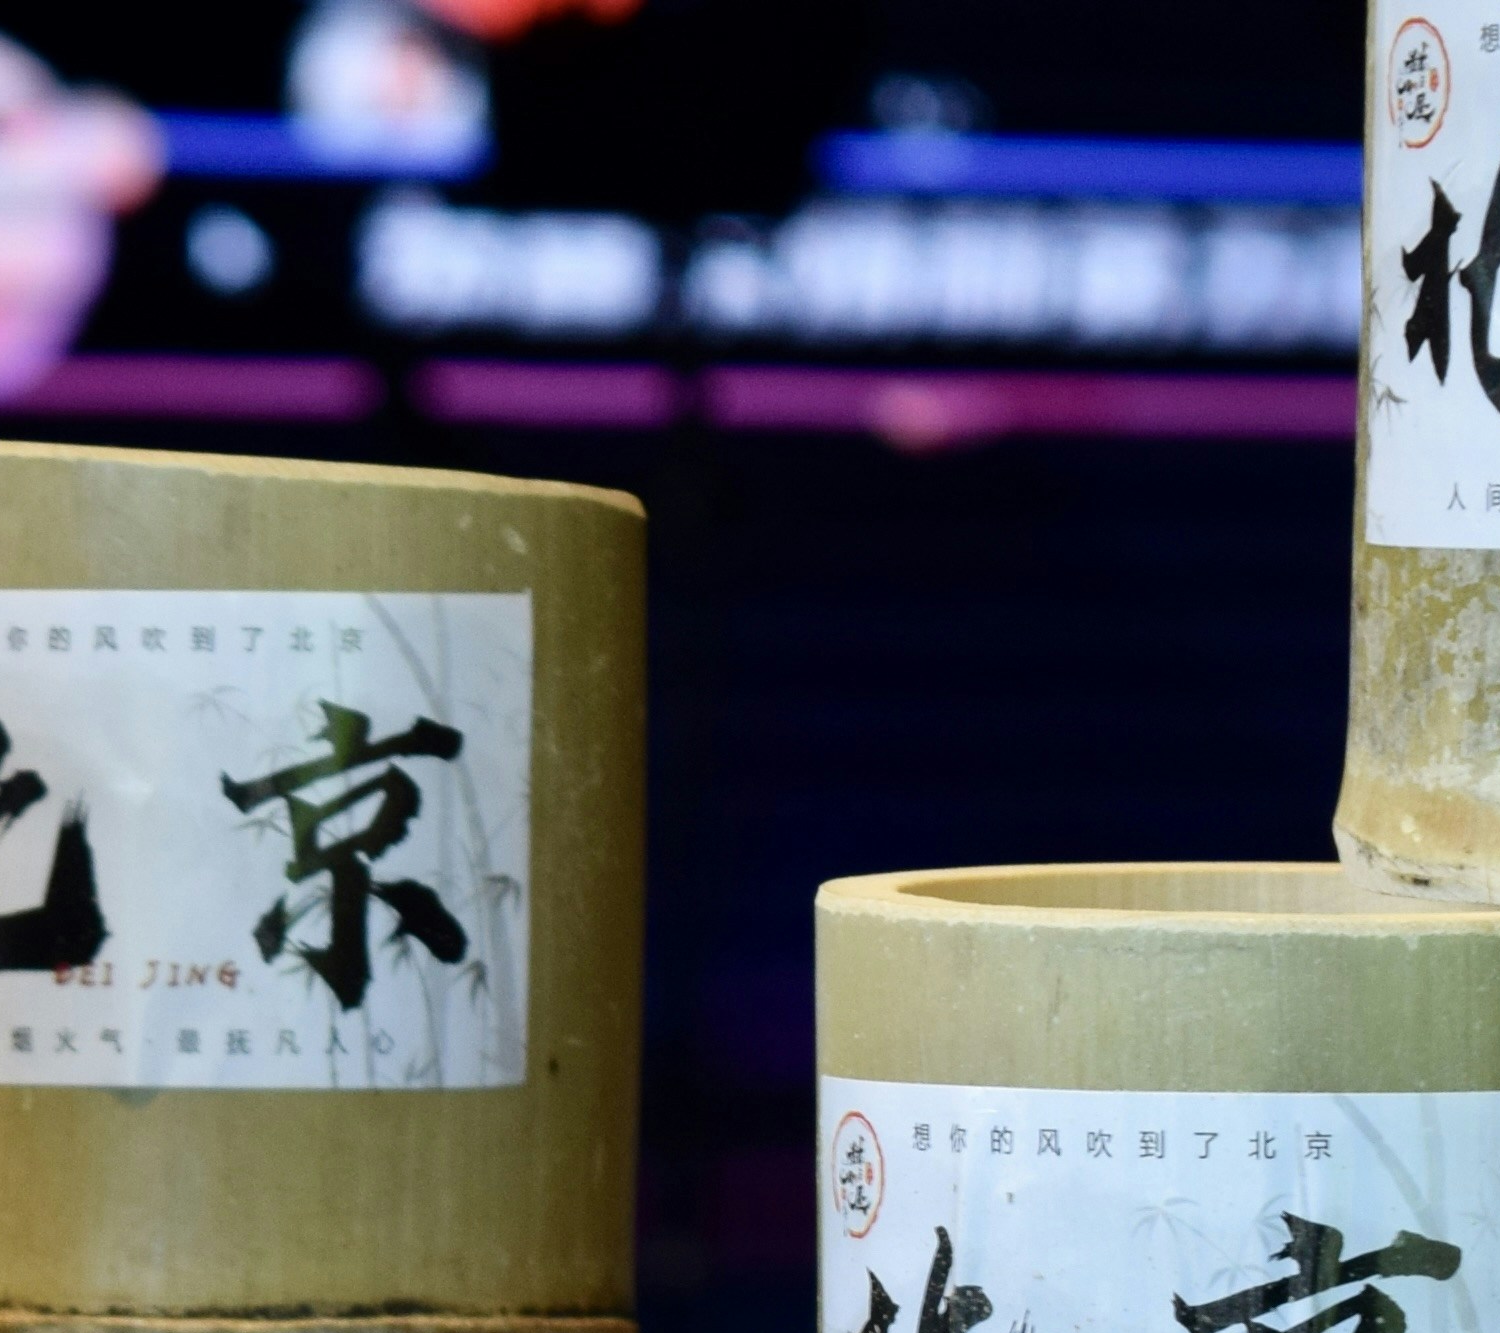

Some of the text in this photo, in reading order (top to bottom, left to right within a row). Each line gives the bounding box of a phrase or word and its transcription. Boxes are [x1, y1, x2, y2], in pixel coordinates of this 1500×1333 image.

[140, 961, 241, 988] JING
[911, 1122, 1334, 1161] 想你的风吹到了北京
